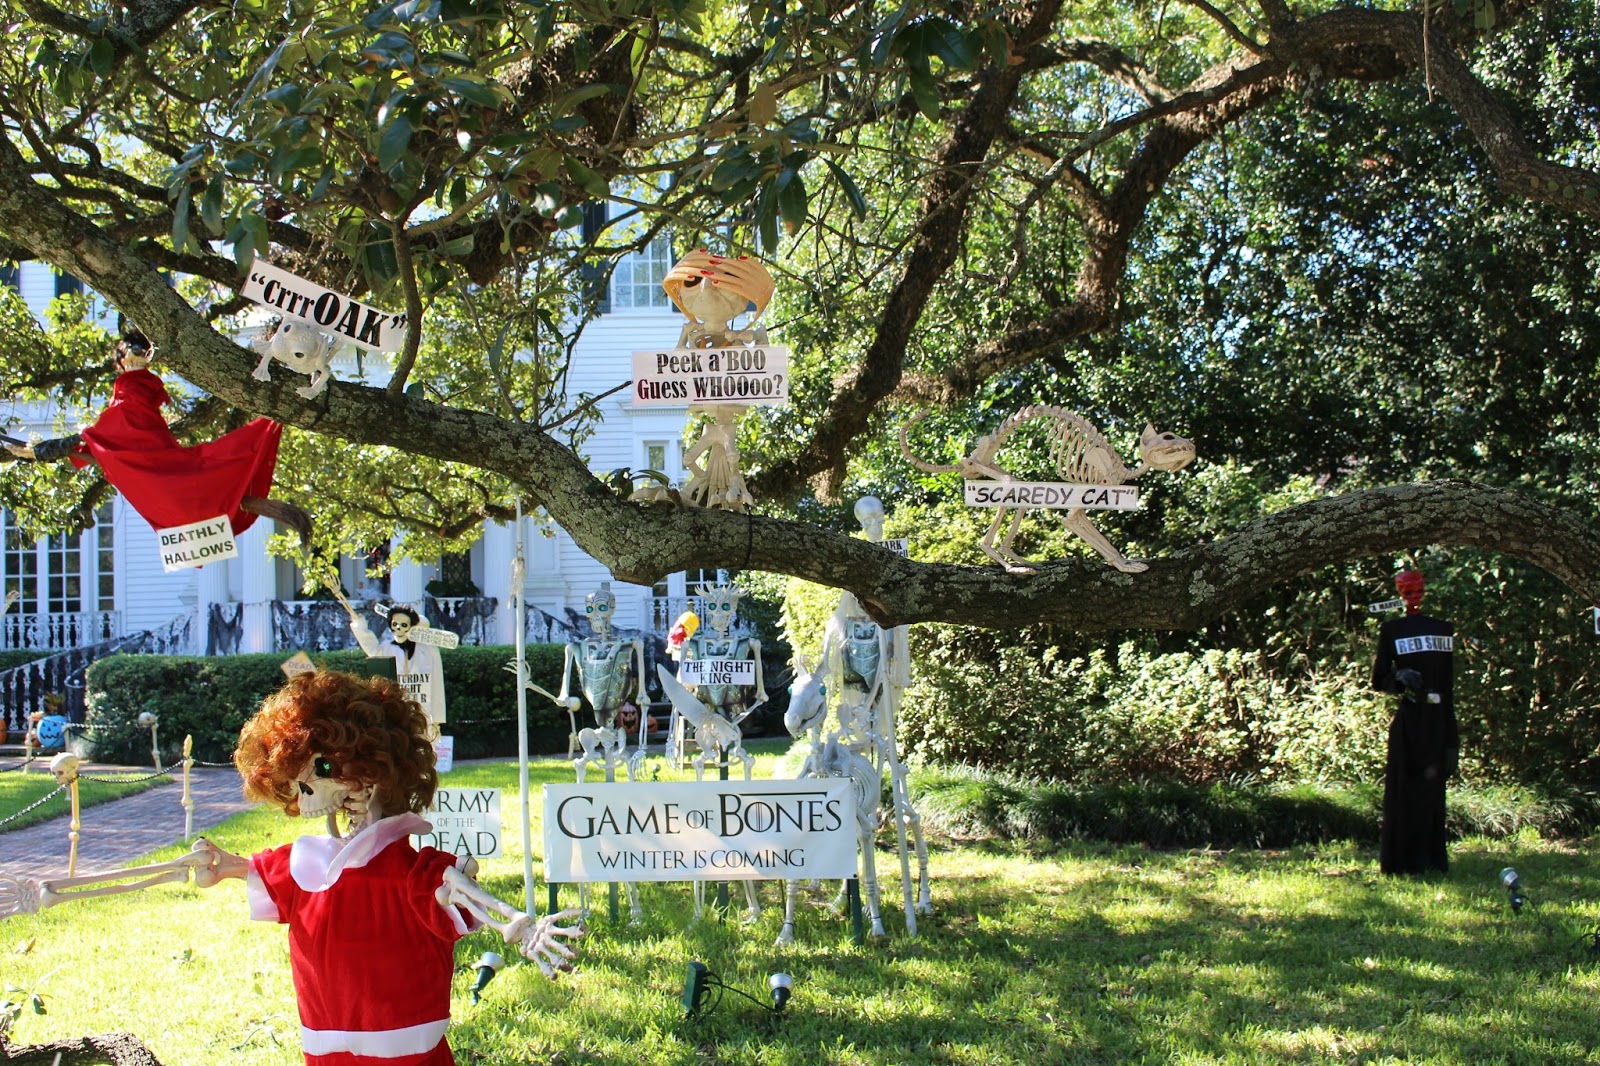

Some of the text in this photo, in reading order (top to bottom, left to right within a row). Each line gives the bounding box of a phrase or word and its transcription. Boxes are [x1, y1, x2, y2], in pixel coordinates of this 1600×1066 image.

[656, 352, 702, 375] Peek
[637, 378, 688, 400] Guess
[967, 485, 1135, 507] "SCAREDY CAT"
[161, 521, 226, 546] DEATHLY
[879, 539, 903, 550] TARK
[164, 540, 234, 565] HALLOWS
[1398, 636, 1452, 653] RED SKULL
[288, 661, 312, 670] DEAD
[684, 661, 753, 673] THE NIGHT
[397, 673, 430, 684] TURDAY
[700, 672, 732, 684] KING
[436, 790, 495, 813] RMY
[437, 817, 476, 828] OF THE
[557, 791, 843, 839] GAME OF BONES
[418, 831, 497, 857] DEAD
[597, 847, 806, 870] WINTER IS COMING
